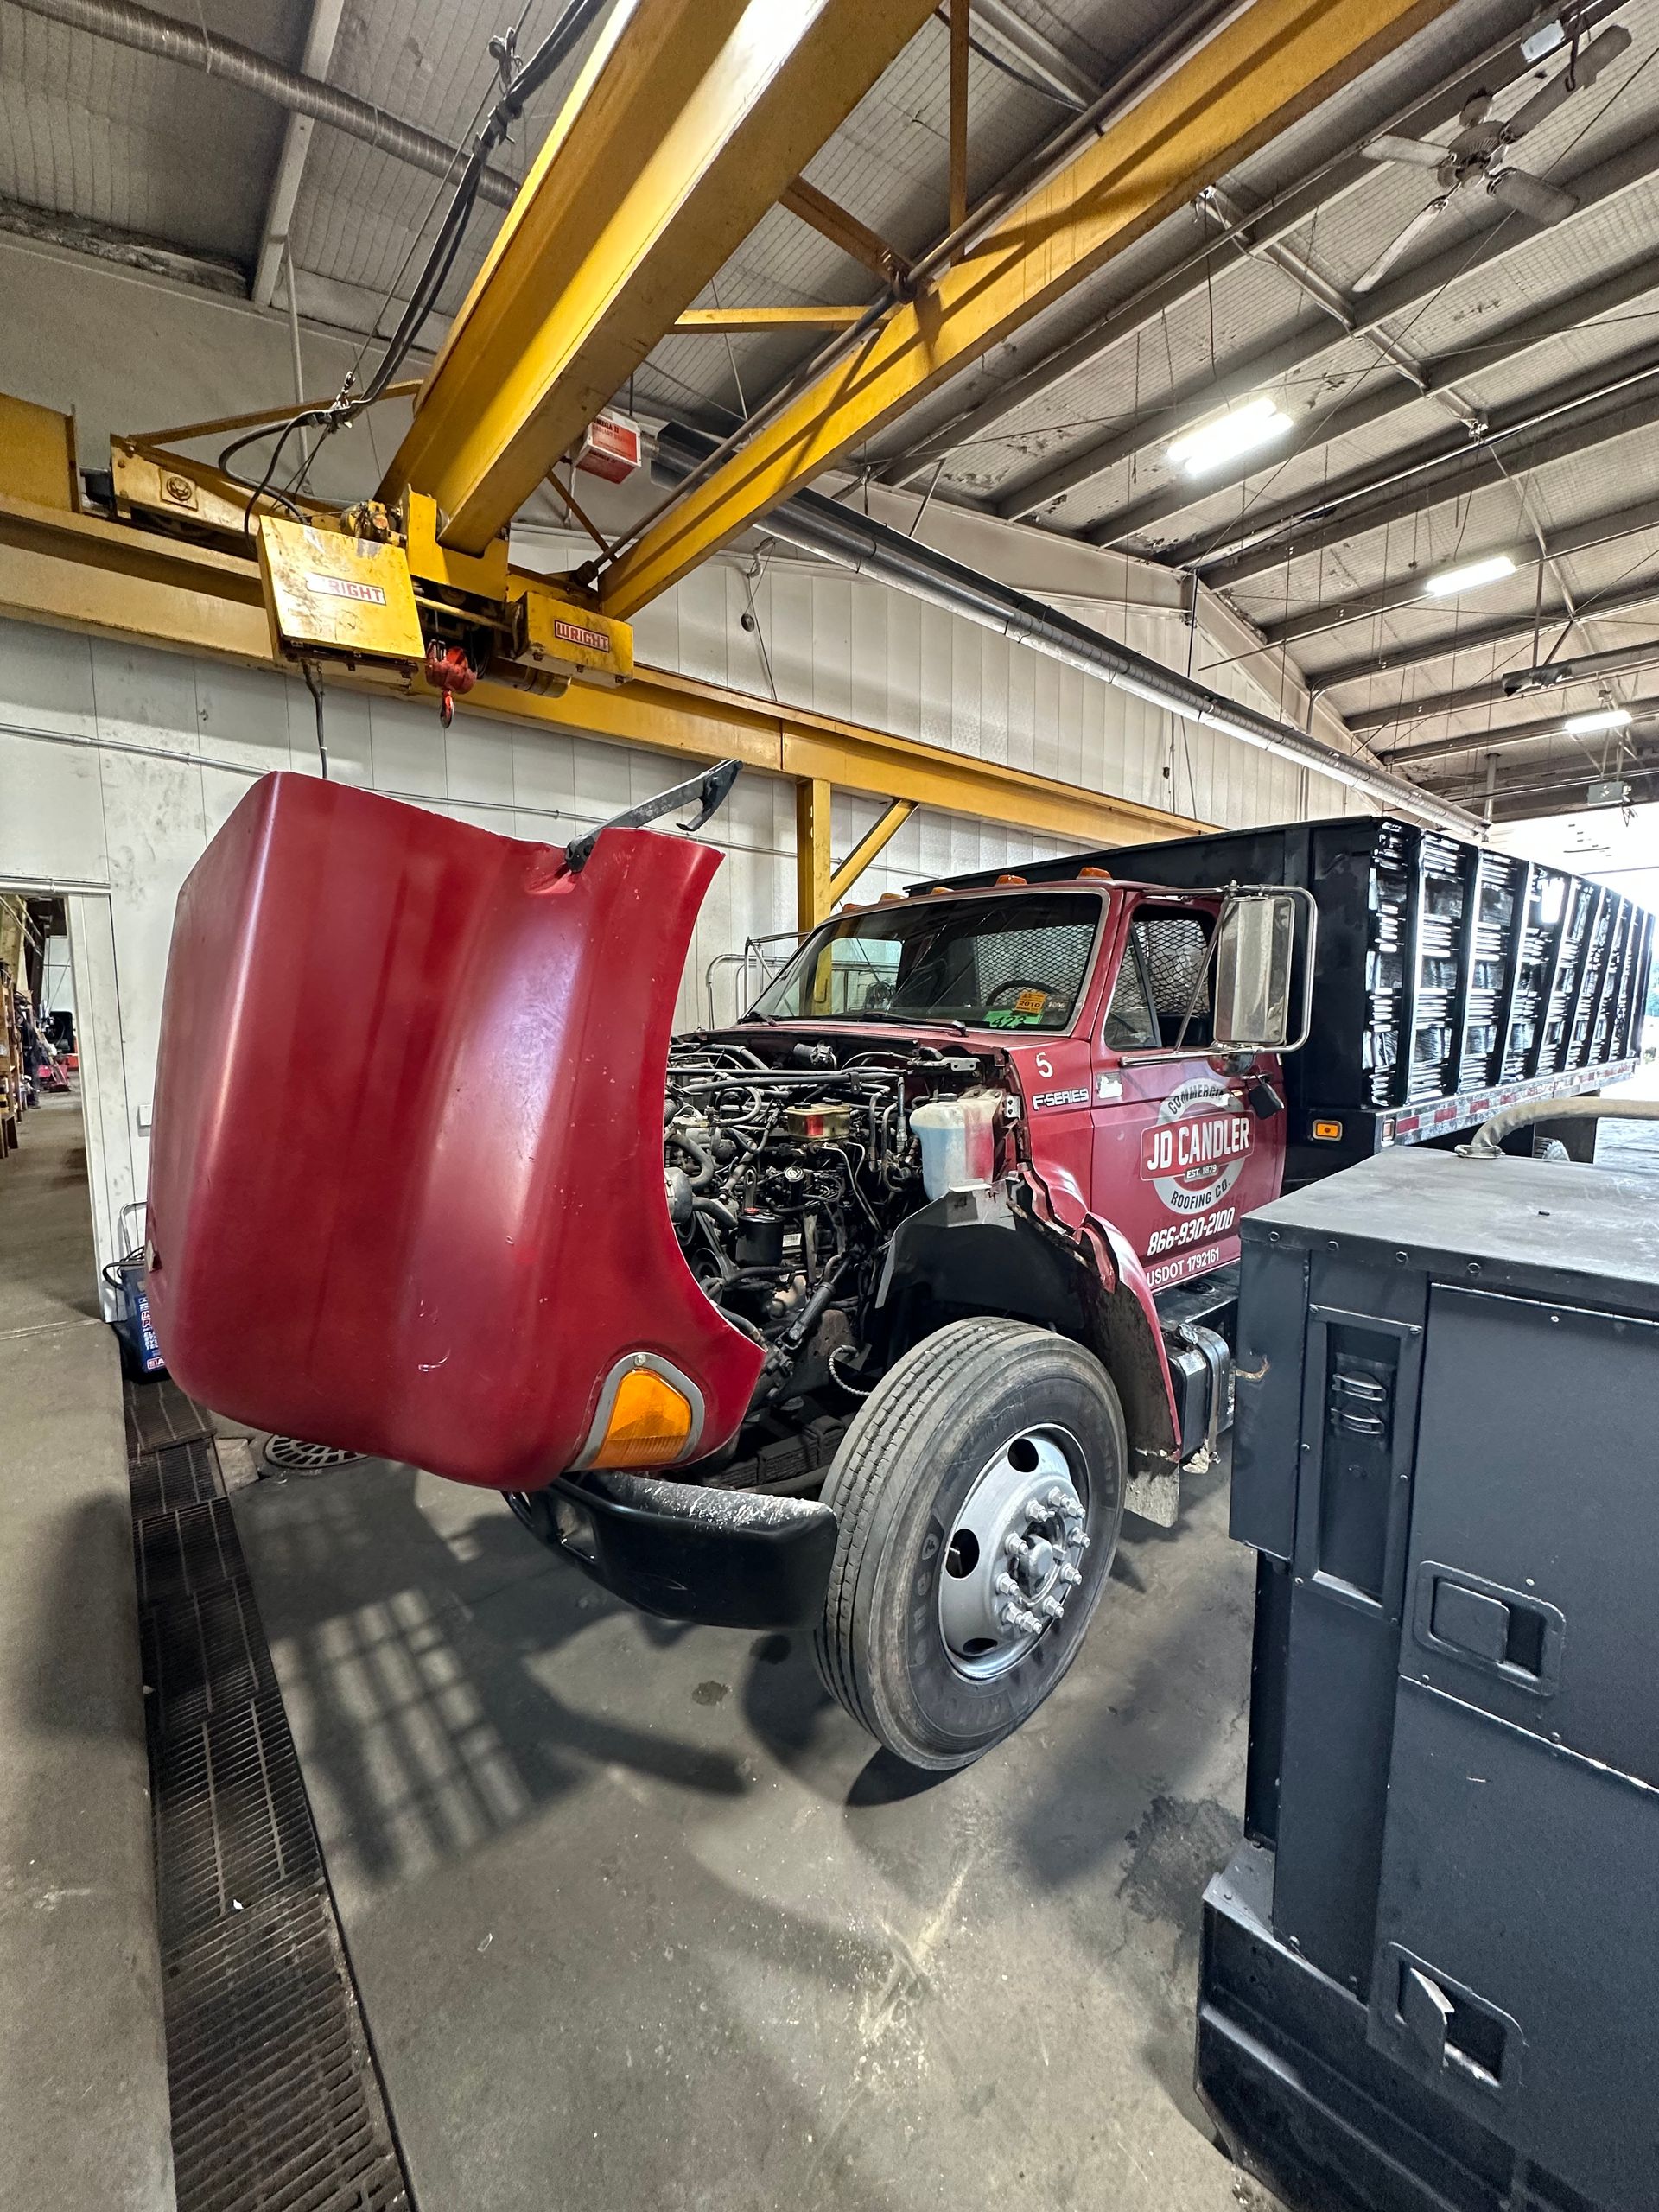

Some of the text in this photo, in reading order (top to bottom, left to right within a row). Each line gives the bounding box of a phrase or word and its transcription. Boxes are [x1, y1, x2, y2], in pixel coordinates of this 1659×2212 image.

[312, 575, 381, 601] RIGHT
[556, 623, 607, 649] WRIGHT
[1036, 1052, 1053, 1078] 5
[1147, 1117, 1249, 1171] JD CANDLER
[1186, 1164, 1217, 1179] EST. 1879
[1171, 1190, 1211, 1210] ROOFING
[1215, 1179, 1231, 1198] CO.
[1147, 1206, 1236, 1256] 866-930-2100
[1147, 1247, 1220, 1287] USDOT 1792161
